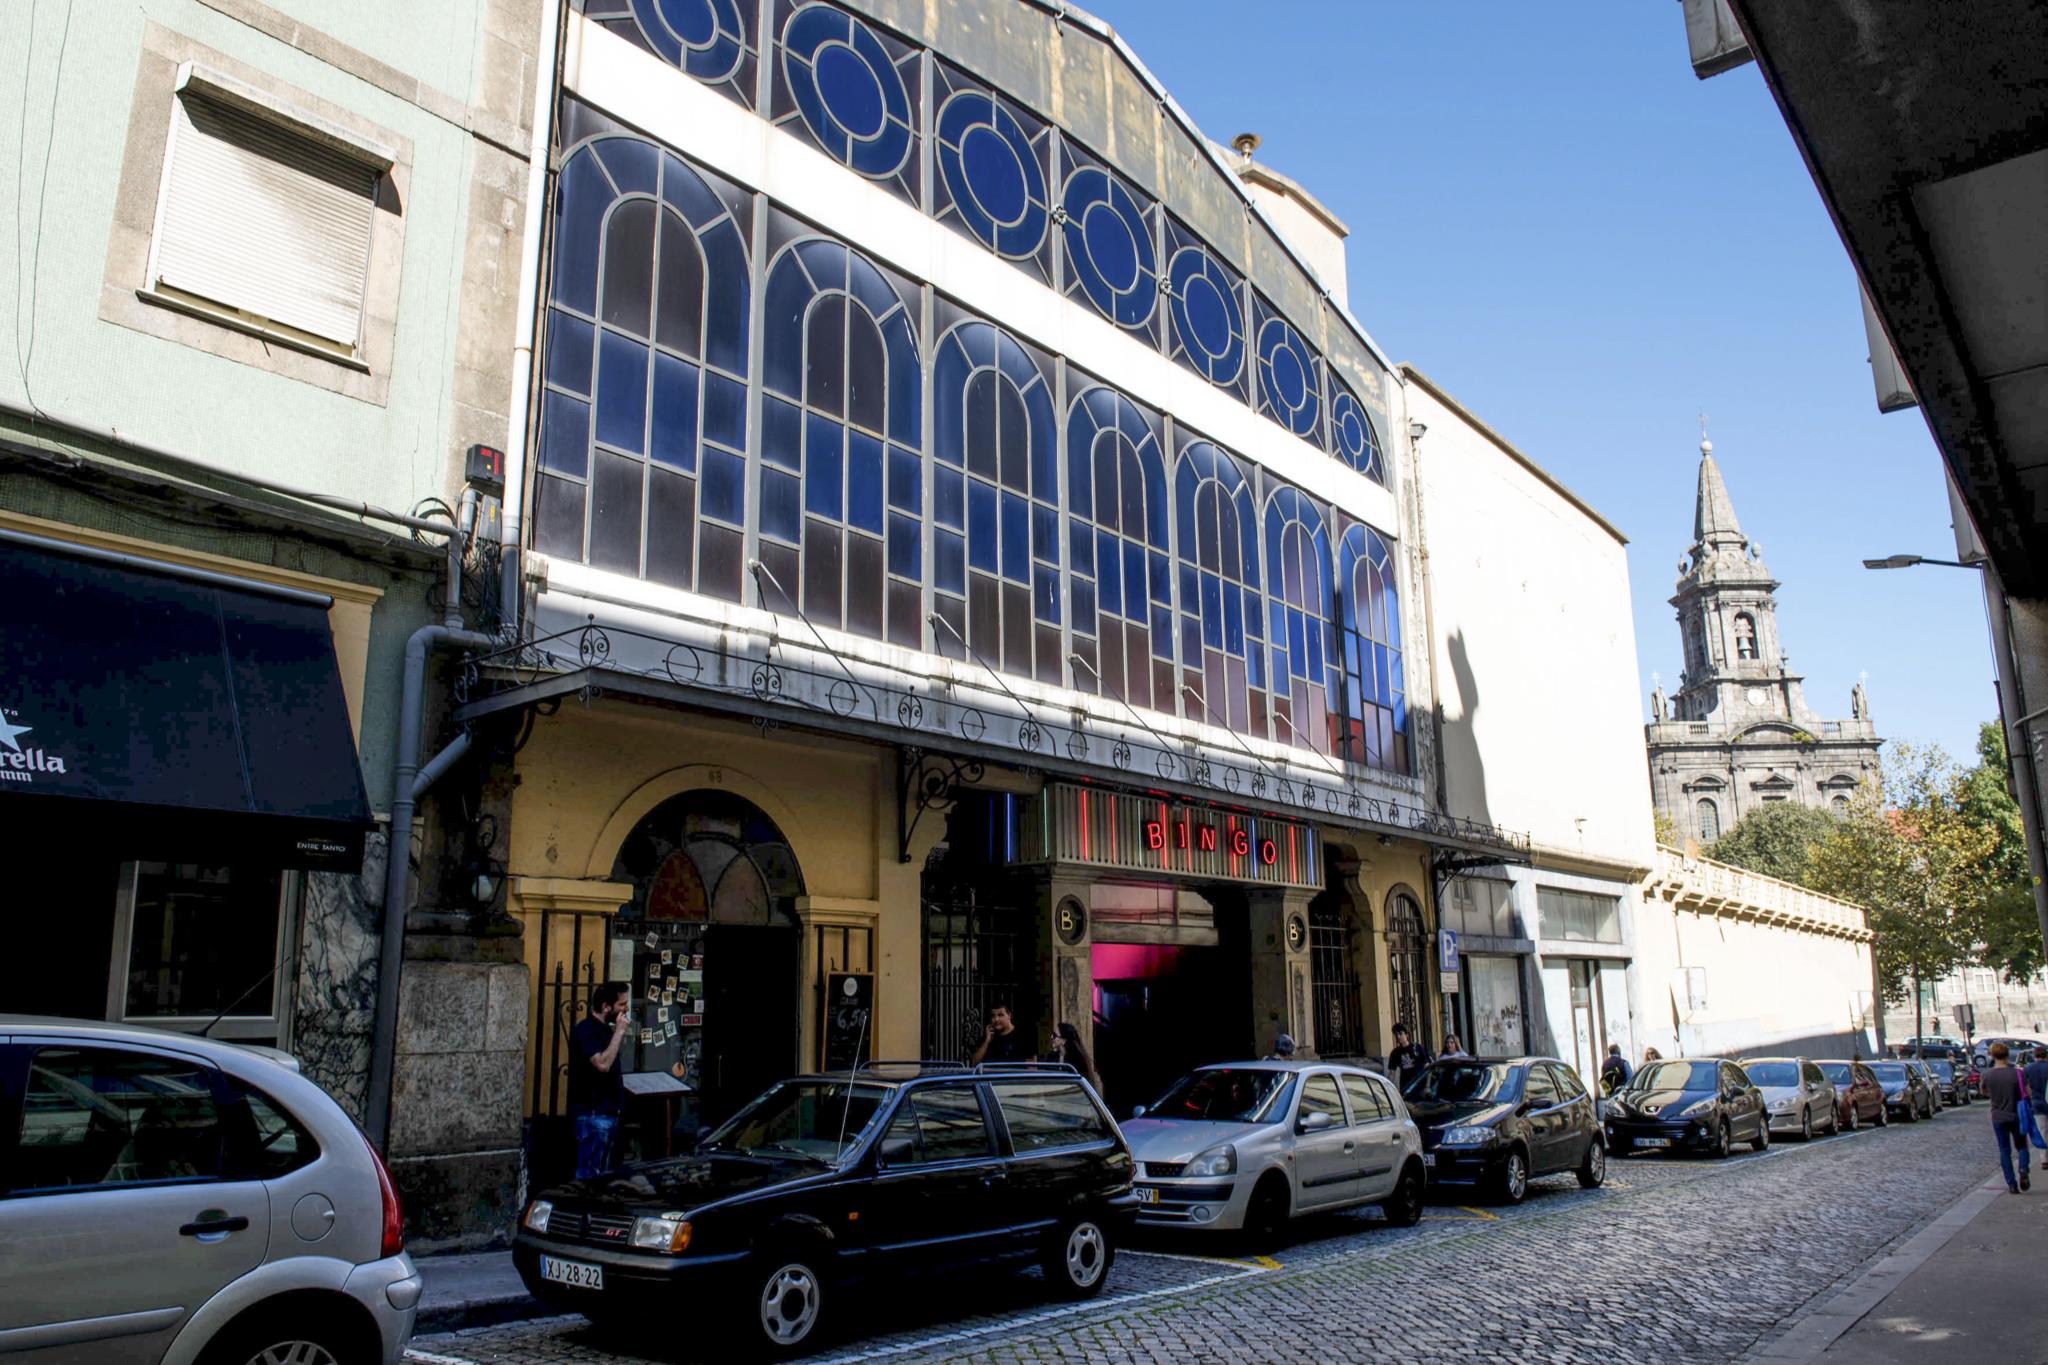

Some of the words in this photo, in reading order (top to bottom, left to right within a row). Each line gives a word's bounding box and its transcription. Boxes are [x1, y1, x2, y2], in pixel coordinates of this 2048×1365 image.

[1147, 822, 1277, 865] BINGO
[1061, 910, 1073, 930] B
[1289, 923, 1298, 940] B
[1443, 934, 1454, 967] P
